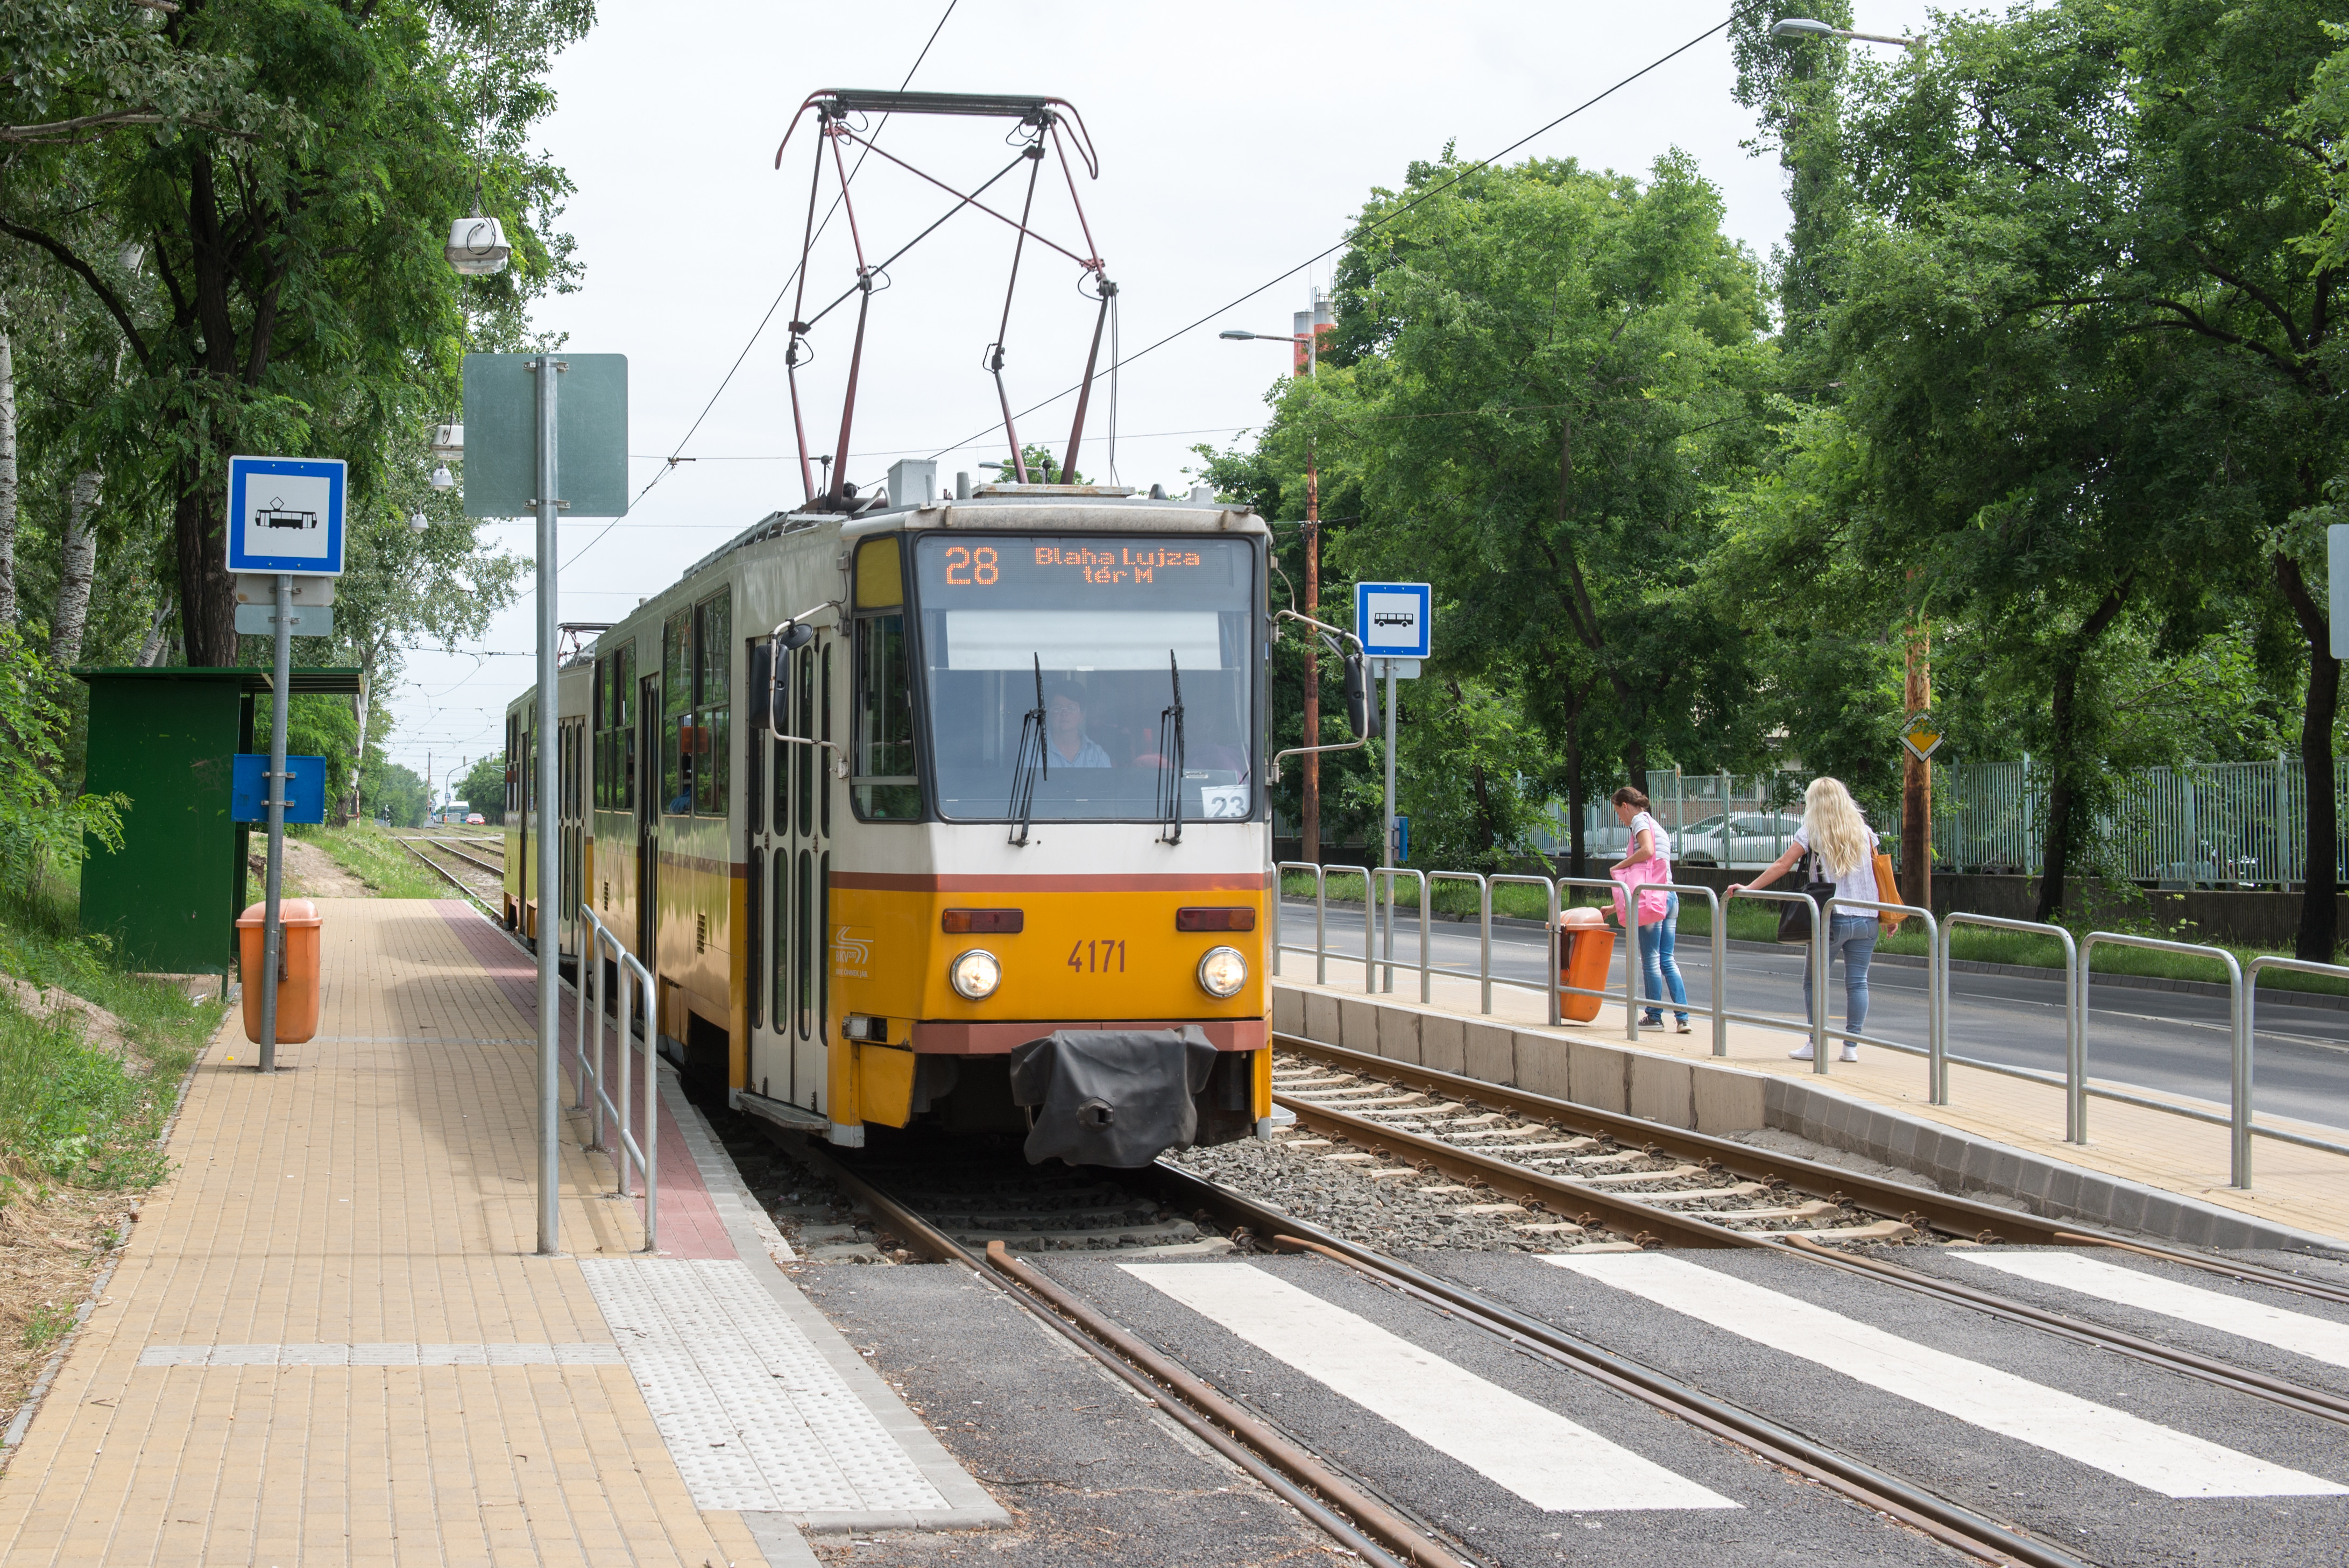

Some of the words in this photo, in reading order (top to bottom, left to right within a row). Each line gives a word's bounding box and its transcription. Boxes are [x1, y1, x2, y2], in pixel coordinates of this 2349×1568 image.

[945, 547, 999, 585] 28
[1035, 548, 1115, 564] Blaha
[1122, 548, 1200, 567] Lujza
[1083, 566, 1128, 583] tér
[1135, 566, 1154, 583] M
[1211, 796, 1247, 818] 23
[1067, 940, 1125, 973] 4171
